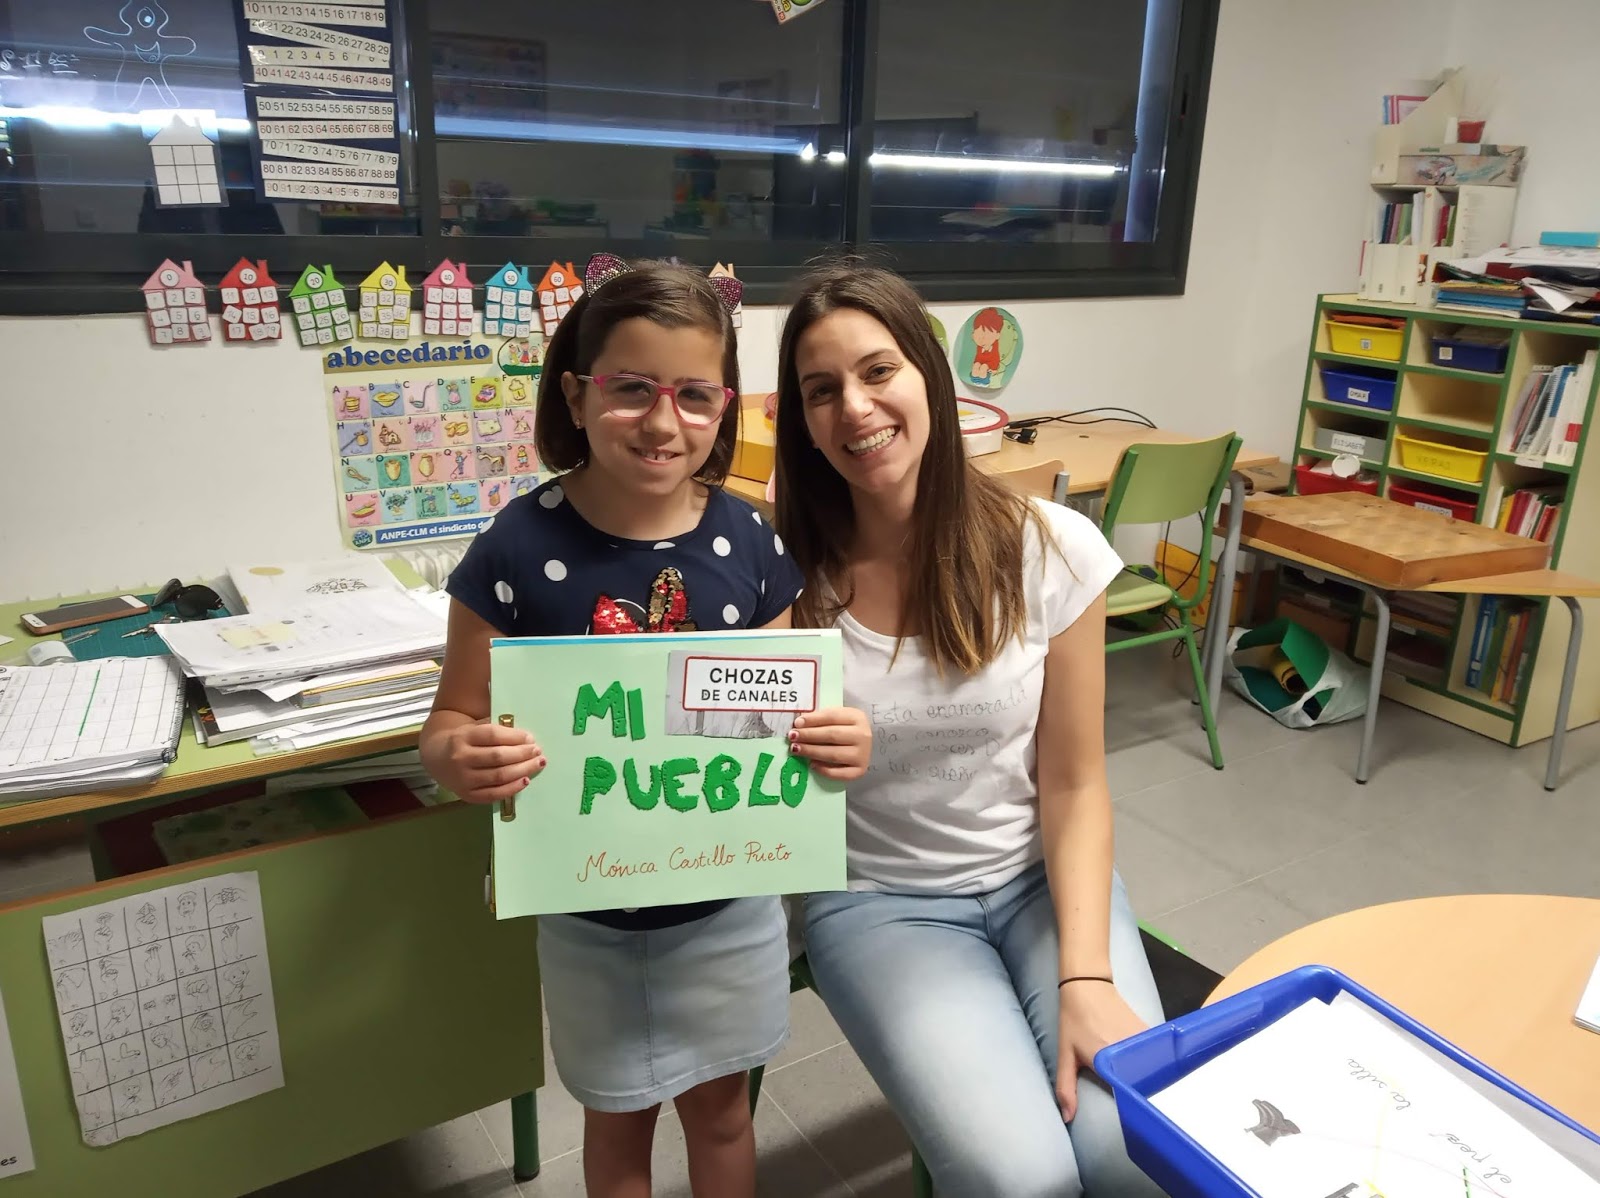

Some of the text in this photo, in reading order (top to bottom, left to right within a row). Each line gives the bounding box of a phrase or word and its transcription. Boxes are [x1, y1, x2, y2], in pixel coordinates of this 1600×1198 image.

[246, 3, 384, 22] 10 11 12 13 14 15 16 17 18 19
[281, 24, 293, 34] 22
[296, 27, 307, 37] 23
[310, 30, 322, 40] 24
[324, 33, 336, 43] 25
[338, 36, 350, 46] 26
[352, 39, 363, 49] 27
[365, 42, 376, 52] 28
[378, 45, 389, 55] 29
[256, 67, 391, 87] 40 41 42 43 44 45 46 47 48 49
[259, 101, 392, 115] 50 51 52 53 54 55 56 57 58 59
[260, 124, 393, 133] 60 61 62 63 64 65 66 67 68 69
[265, 140, 397, 165] 70 71 72 73 74 75 76 77 78 79
[263, 164, 395, 179] 80 81 82 83 84 85 86 87 88 89
[244, 273, 254, 281] 10
[310, 277, 320, 285] 20
[384, 279, 393, 287] 30
[177, 327, 183, 335] 8
[327, 340, 490, 368] abecedario
[341, 458, 349, 466] N
[414, 486, 422, 494] W
[381, 527, 427, 540] ANPE-CLM
[429, 526, 437, 534] el
[439, 521, 476, 533] sindicato
[709, 668, 793, 685] CHOZAS
[701, 689, 798, 702] DE CANALES
[573, 680, 646, 742] MI
[579, 752, 808, 814] PUEBLO
[577, 841, 792, 883] Mónica Castillo Prieto
[1390, 1091, 1411, 1110] la
[1483, 1167, 1512, 1184] el
